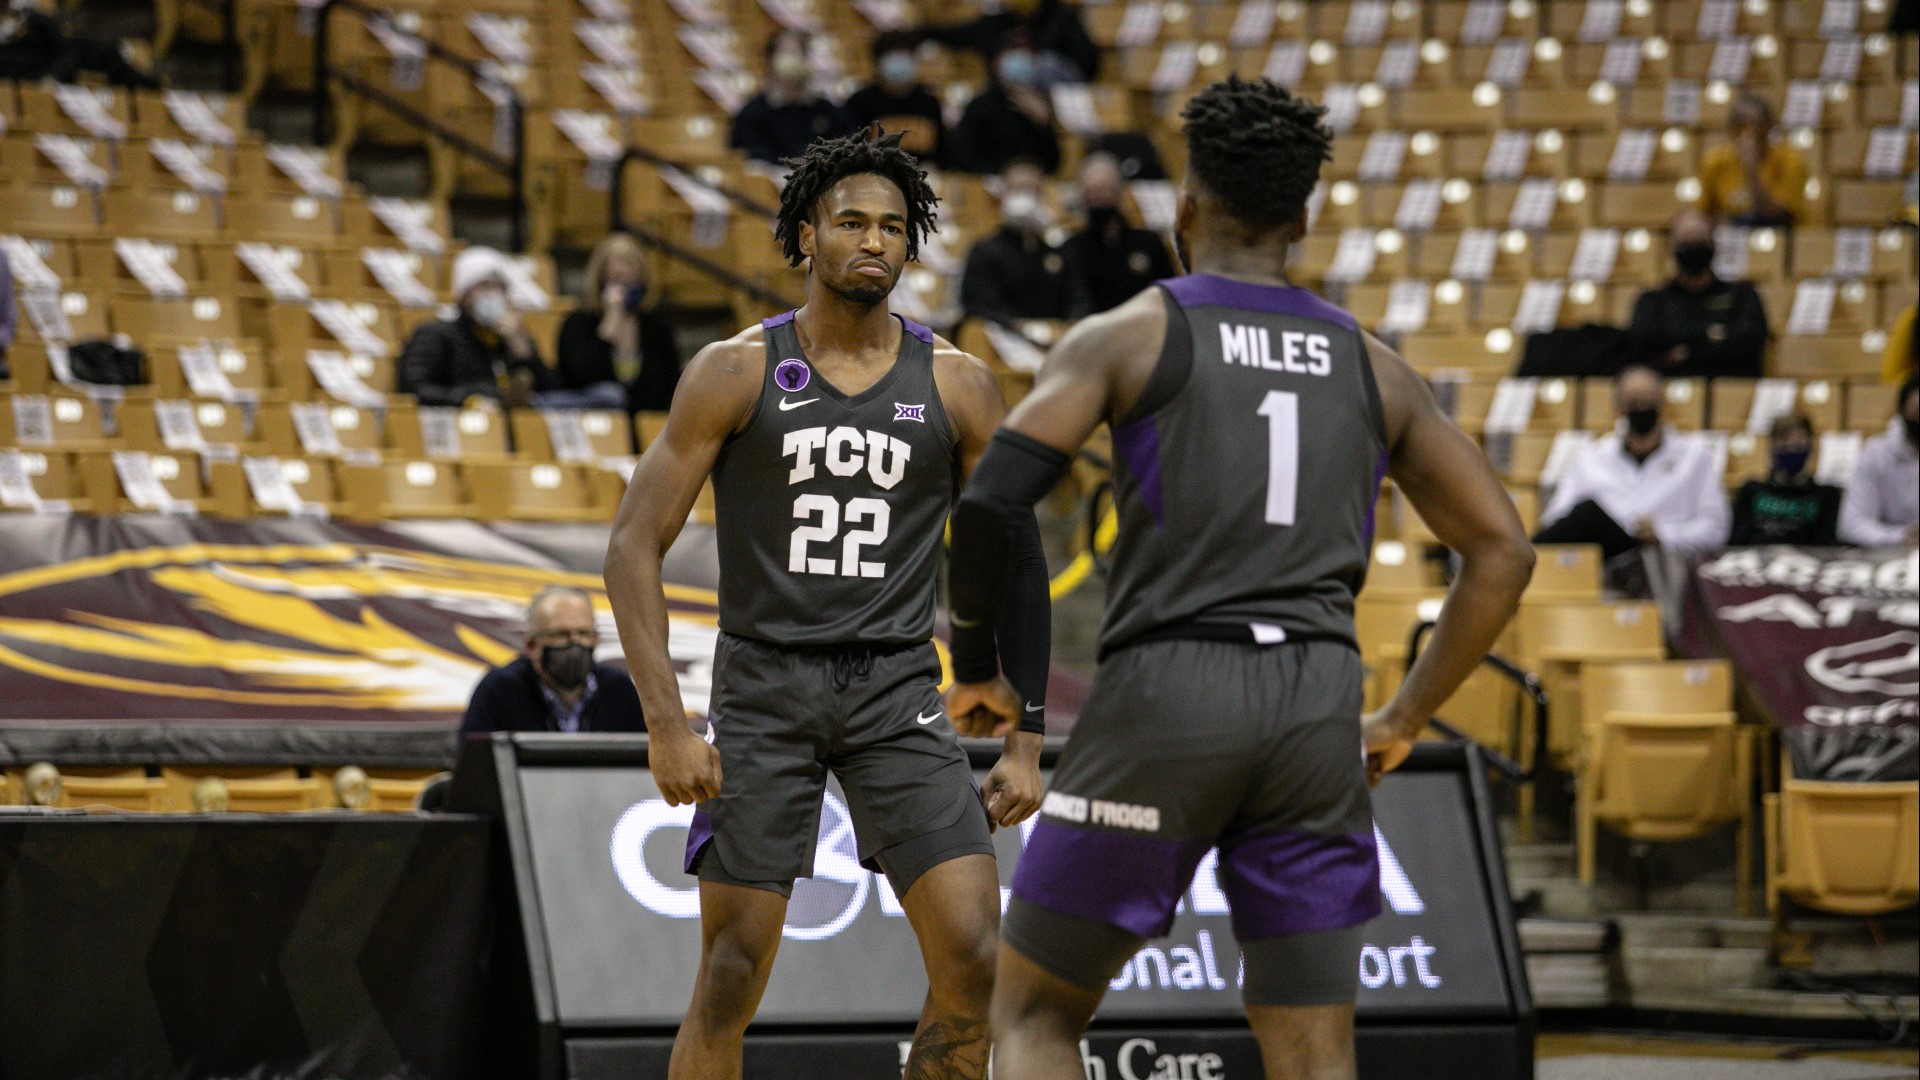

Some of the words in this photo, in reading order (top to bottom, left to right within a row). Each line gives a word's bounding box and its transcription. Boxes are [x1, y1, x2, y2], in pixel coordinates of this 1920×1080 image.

[1219, 322, 1332, 377] MILES
[895, 404, 923, 421] XII
[782, 426, 911, 490] TCU
[1256, 390, 1299, 526] 1
[789, 494, 891, 578] 22
[1091, 800, 1160, 832] FROGS
[1117, 1037, 1226, 1080] Care
